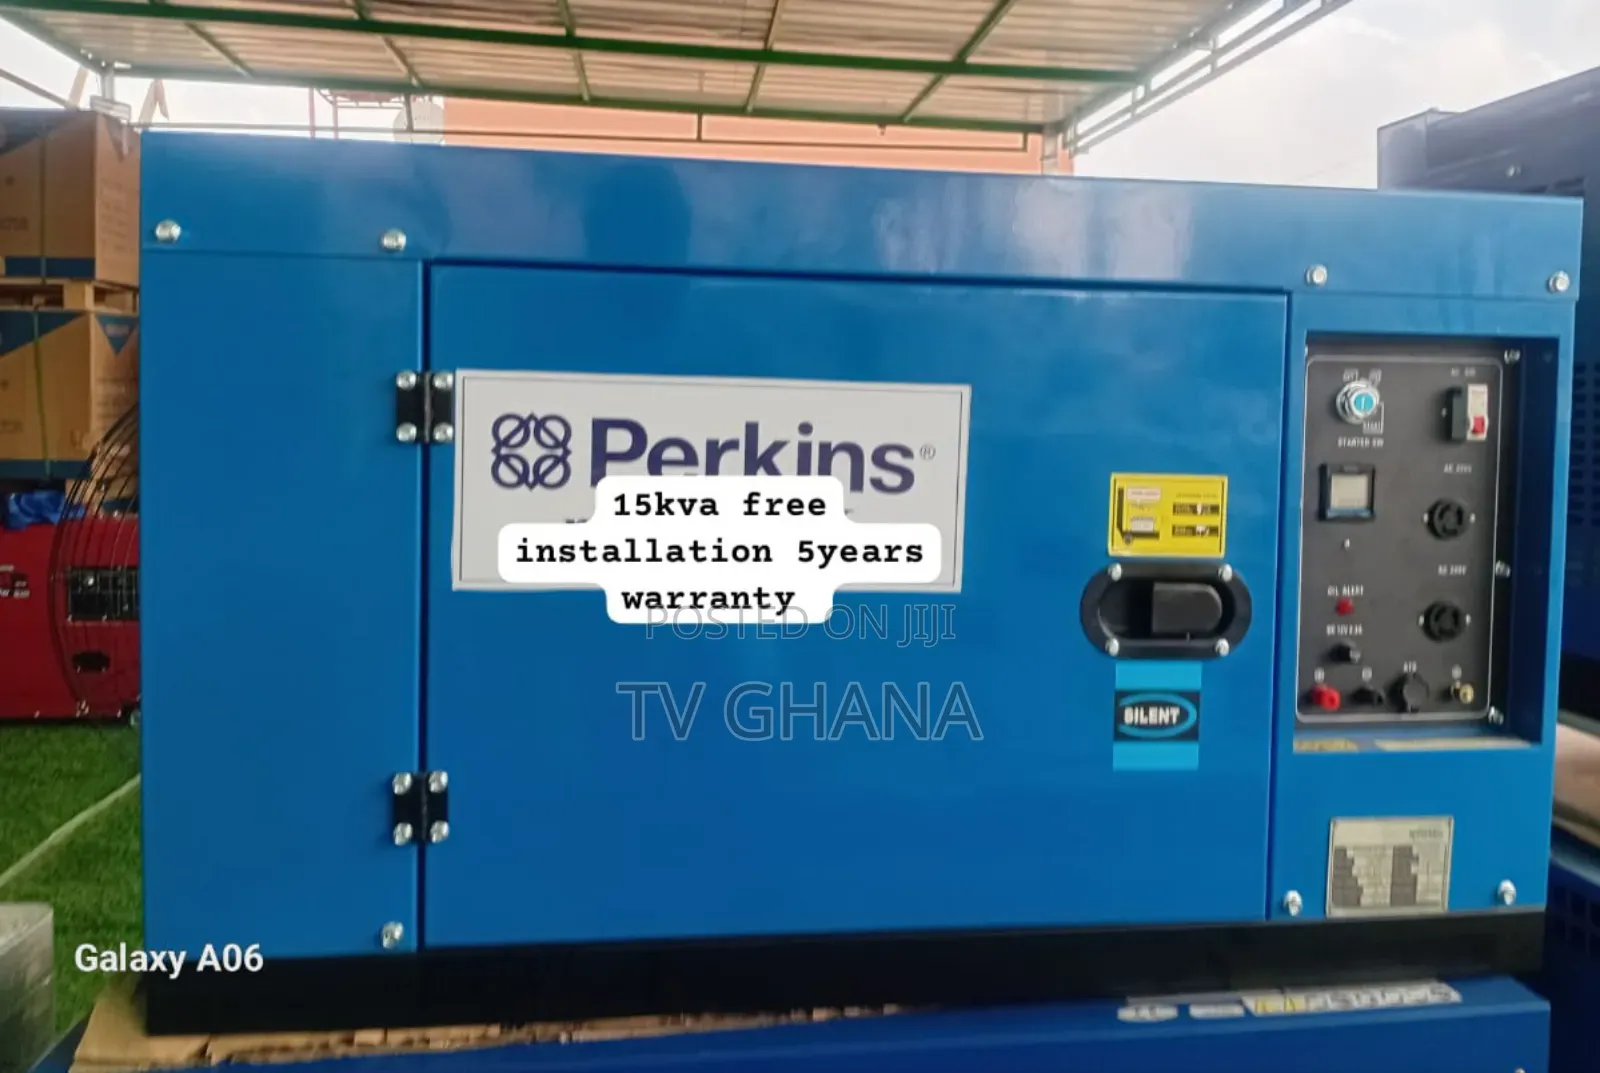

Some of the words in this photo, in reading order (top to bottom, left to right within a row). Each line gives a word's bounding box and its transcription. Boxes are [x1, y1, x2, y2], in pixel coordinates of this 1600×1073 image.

[590, 417, 916, 495] Perkins
[1342, 584, 1364, 597] ALERT
[1123, 706, 1180, 726] SILENT
